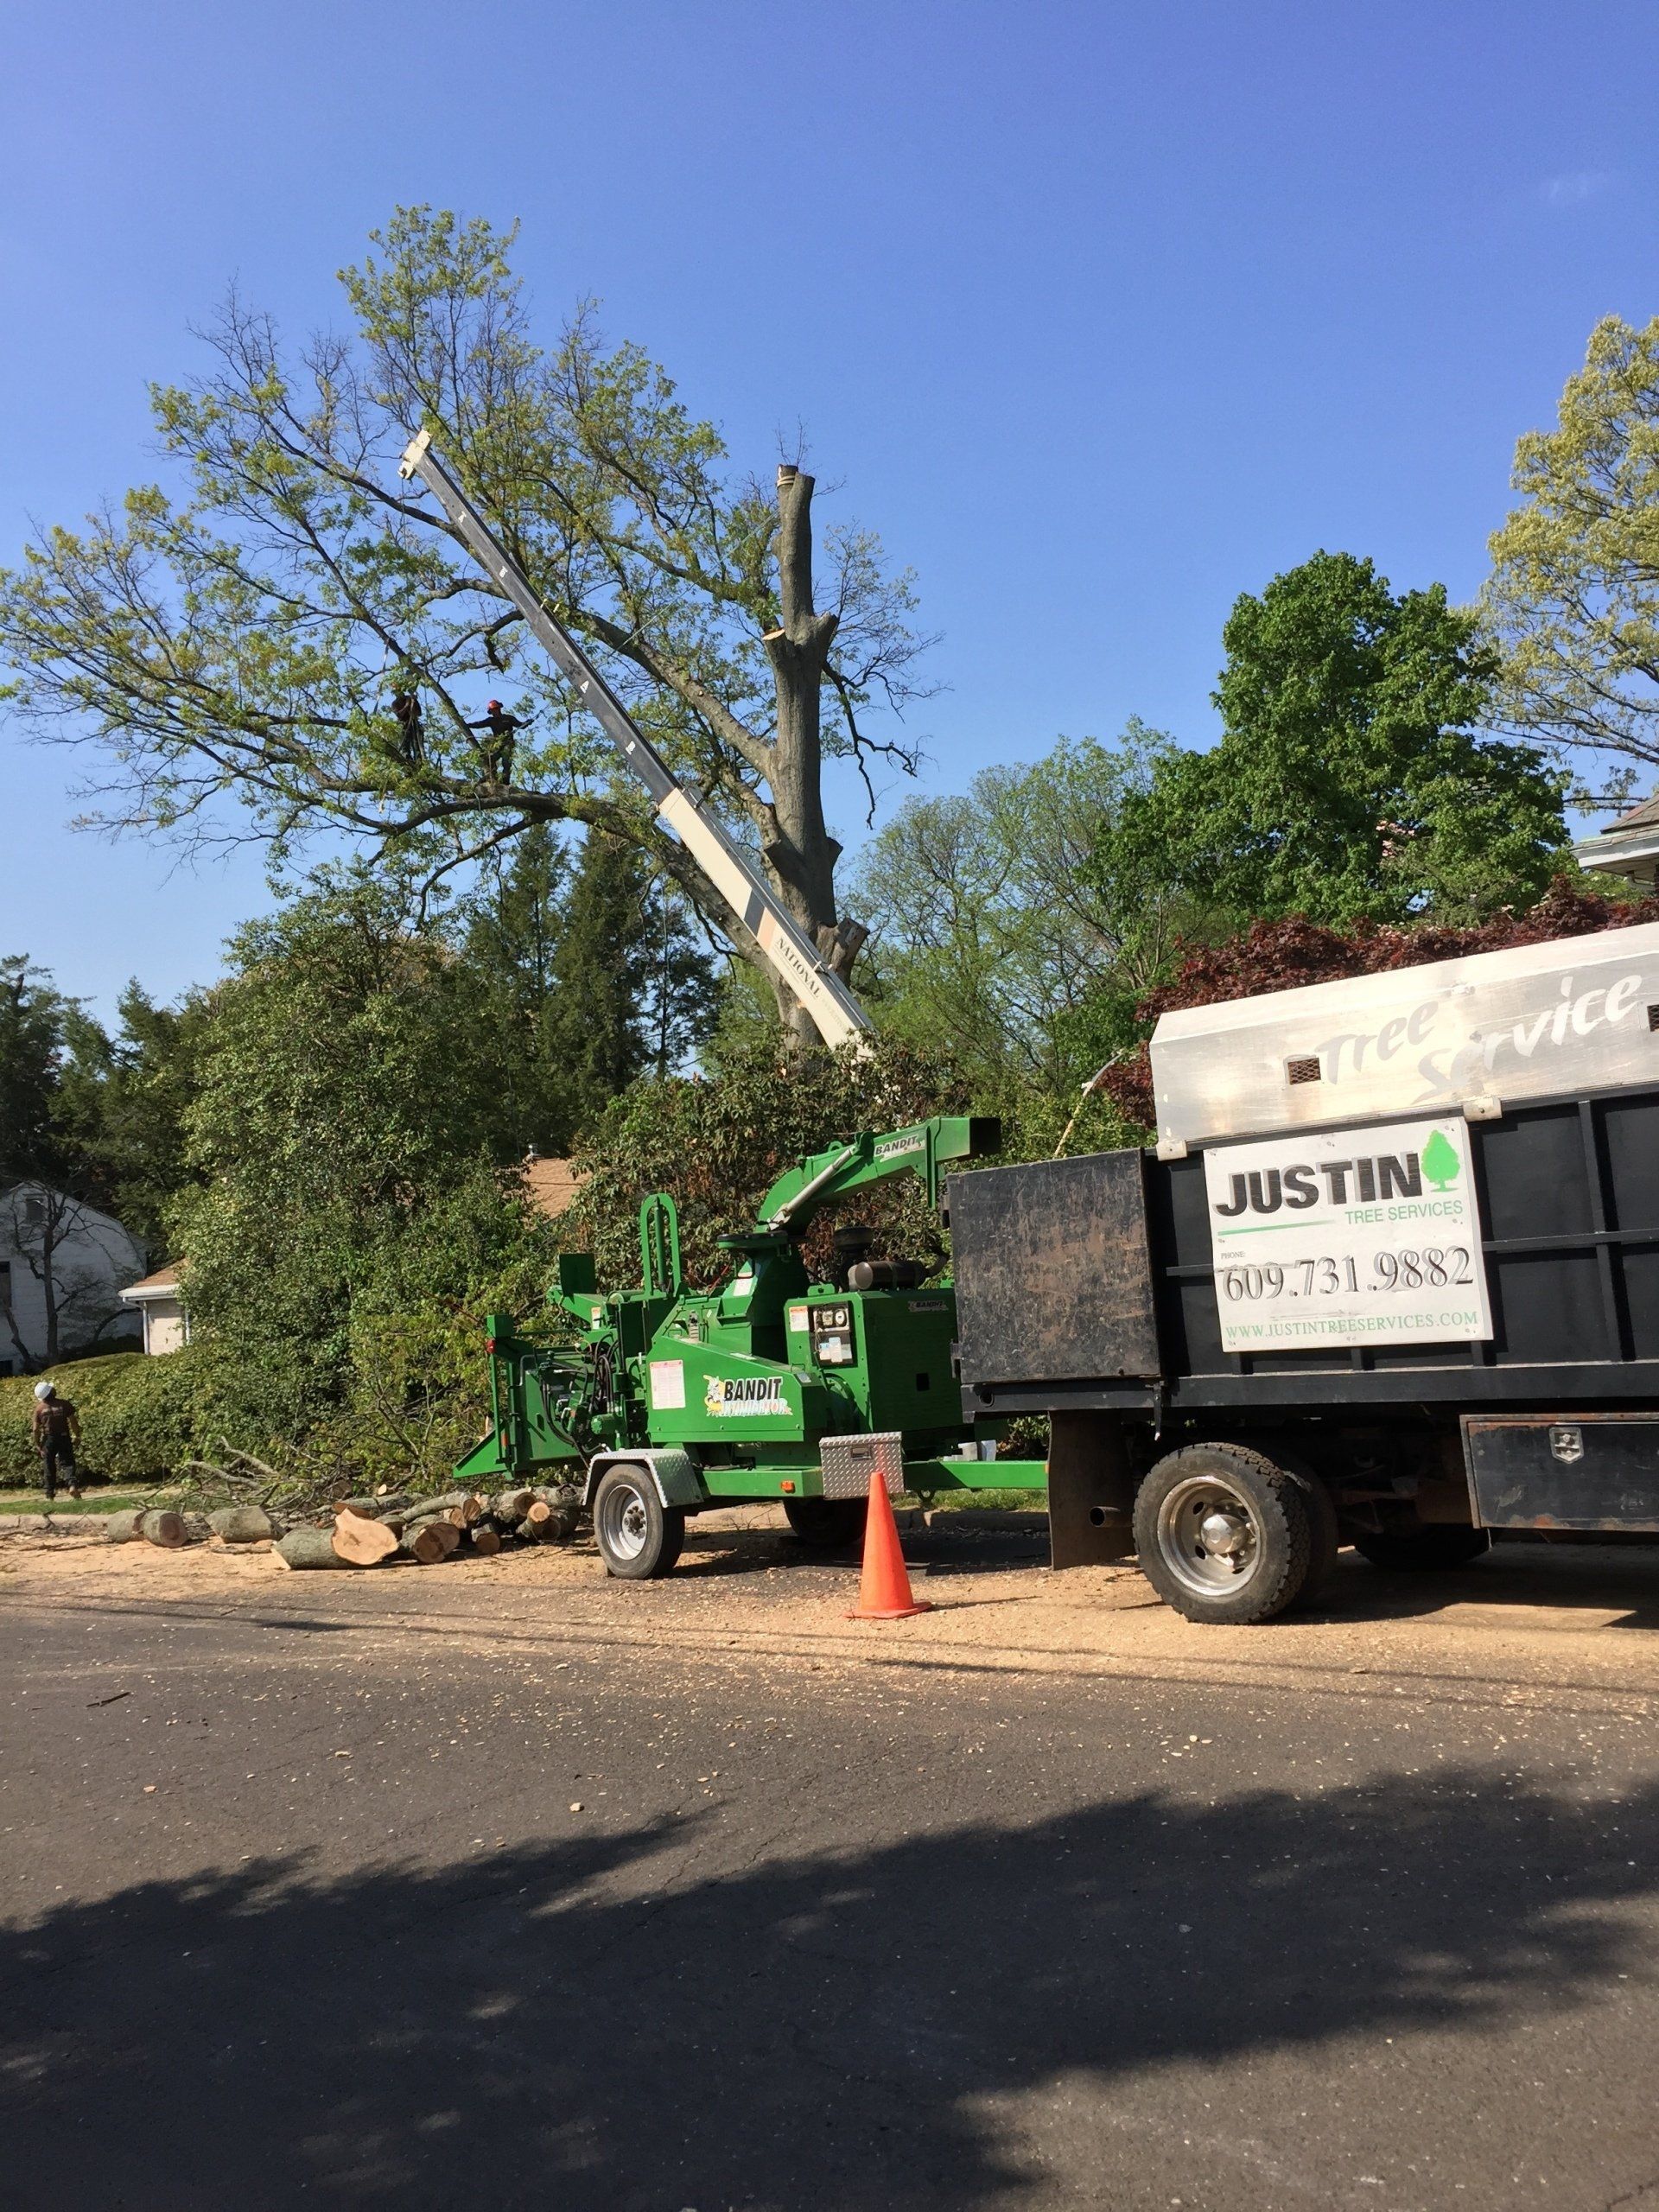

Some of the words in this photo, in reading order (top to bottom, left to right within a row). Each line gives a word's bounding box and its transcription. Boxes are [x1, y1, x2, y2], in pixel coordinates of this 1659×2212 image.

[777, 938, 821, 999] NATIONAL
[1314, 1000, 1439, 1084] Tree
[1410, 975, 1643, 1105] Service
[874, 1135, 918, 1155] BANDIT
[1211, 1151, 1422, 1217] JUSTIN
[1344, 1209, 1384, 1225] TREE
[1388, 1199, 1463, 1222] SERVICES
[1222, 1244, 1474, 1302] 609.731.9882
[1224, 1311, 1478, 1339] WWW.JUSTINTREESERVICES.COM
[723, 1377, 782, 1402] BANDIT
